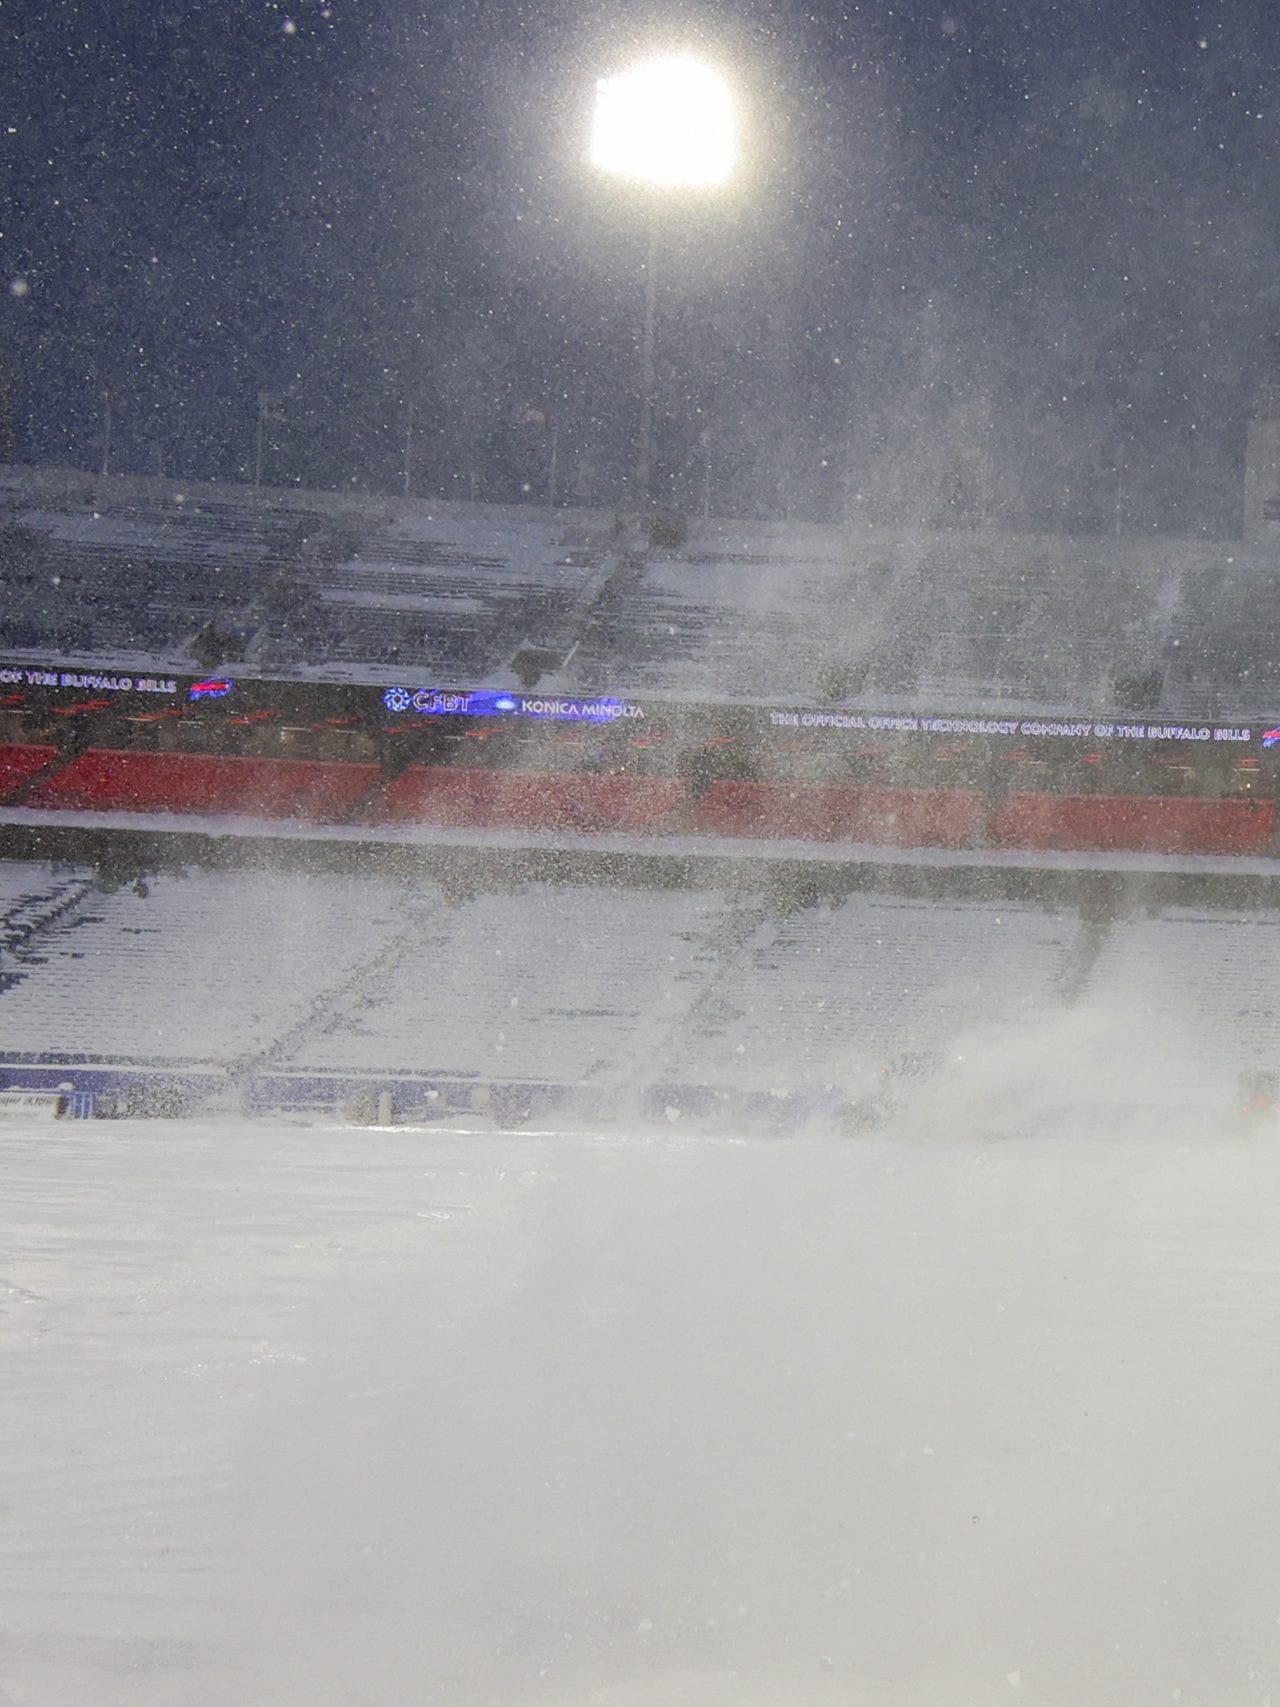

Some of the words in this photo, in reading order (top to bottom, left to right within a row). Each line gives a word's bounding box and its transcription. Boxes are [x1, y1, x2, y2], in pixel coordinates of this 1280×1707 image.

[0, 670, 22, 683] OF
[25, 671, 58, 687] THE
[61, 672, 133, 691] BUFFALO
[135, 677, 177, 694] BILLS
[412, 691, 472, 712] CFBT
[521, 700, 579, 717] KONICA
[580, 704, 645, 720] MINOLTA
[769, 710, 799, 726] THE
[801, 712, 866, 729] OFFICIAL
[868, 715, 918, 732] OFFICE
[920, 717, 1018, 735] TECHNOLOGY
[1020, 720, 1092, 737] COMPANY
[1093, 724, 1115, 738] OF
[1116, 725, 1145, 739] THE
[1147, 726, 1211, 741] BUFFALO
[1213, 727, 1251, 742] BILLS
